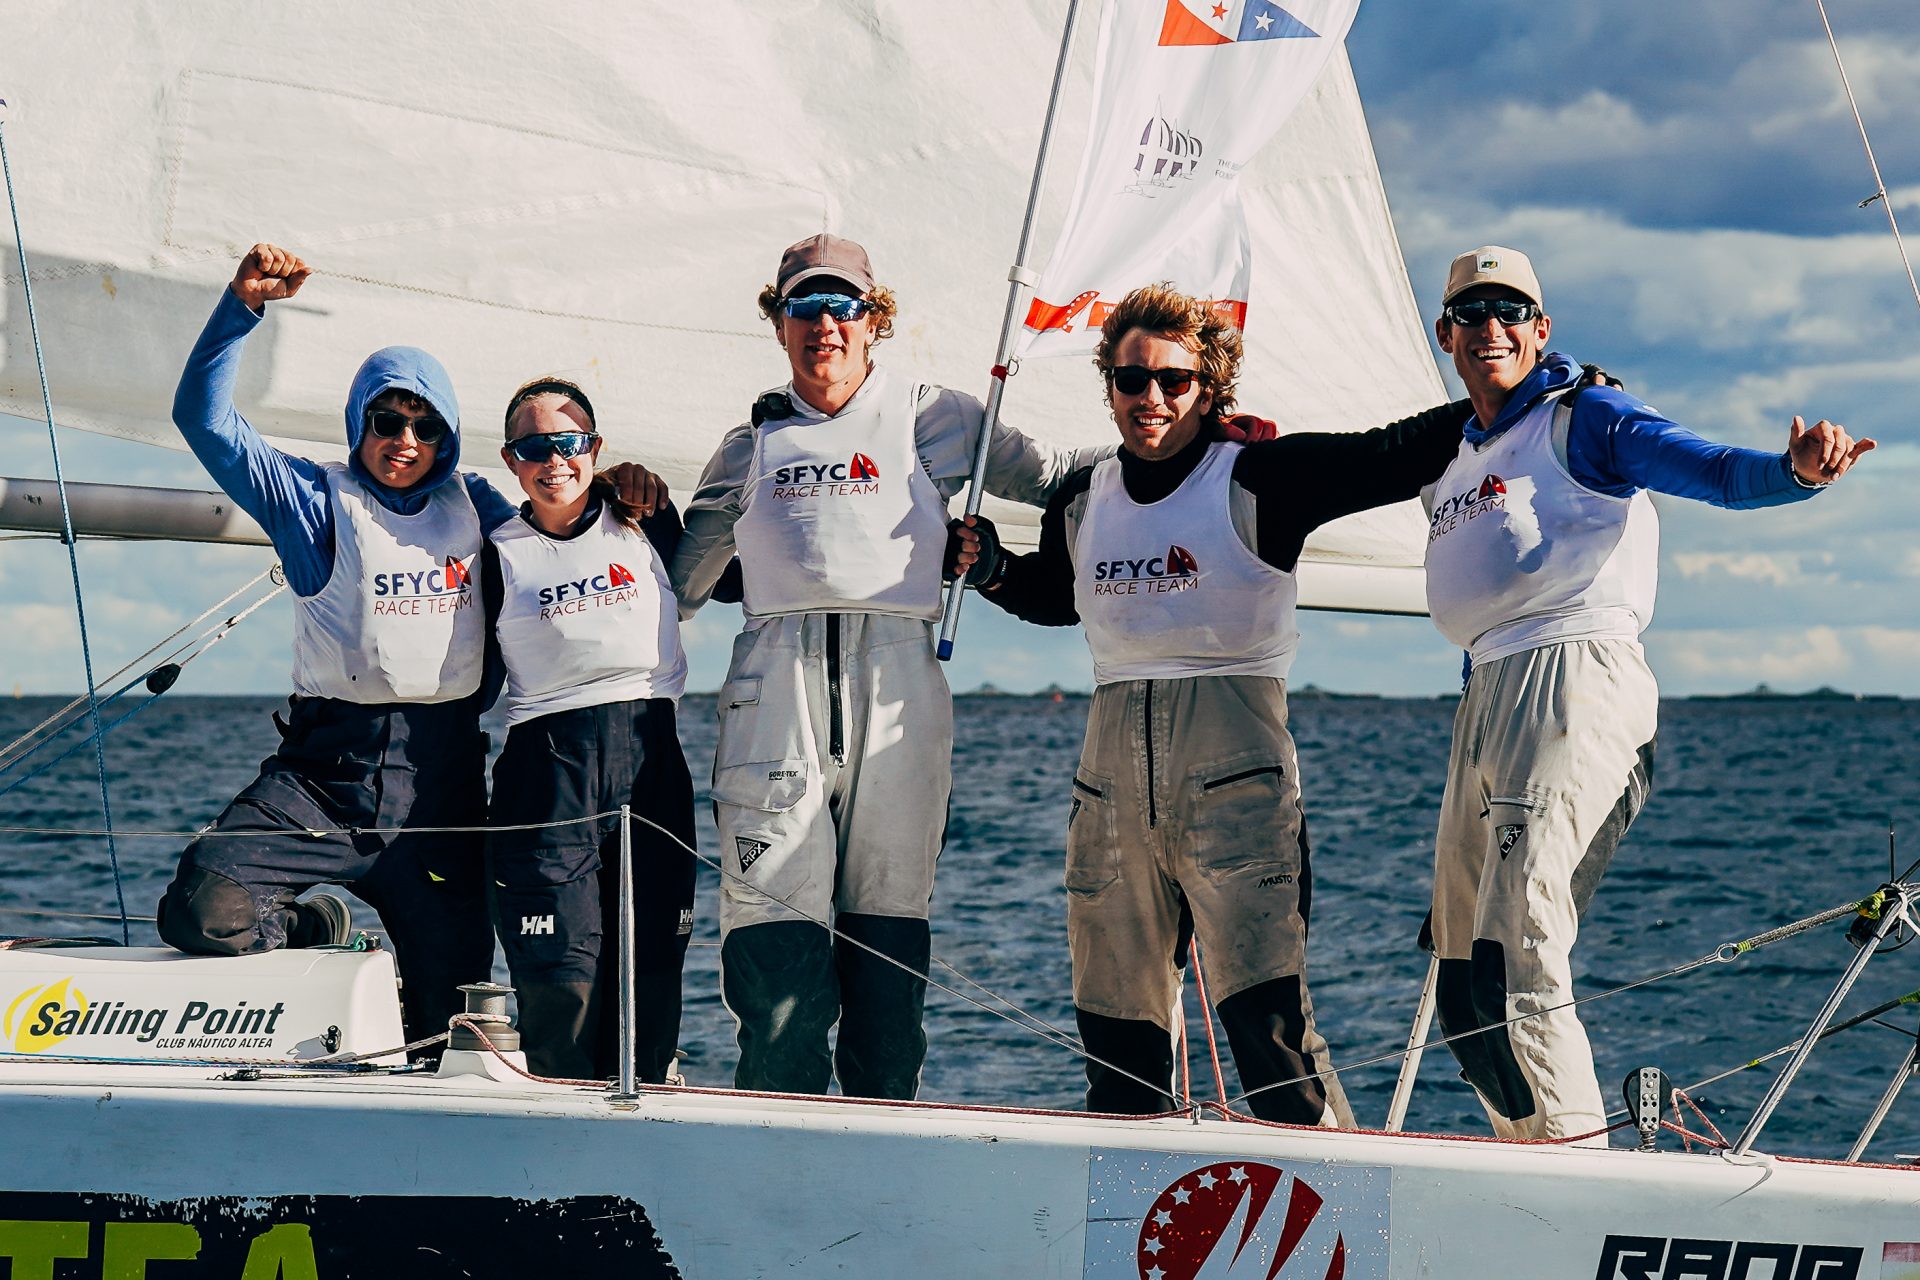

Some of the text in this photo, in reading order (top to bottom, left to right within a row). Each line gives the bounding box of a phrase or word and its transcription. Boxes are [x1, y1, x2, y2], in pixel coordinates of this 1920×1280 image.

[774, 463, 847, 485] SFYC
[773, 483, 879, 499] RACE TEAM
[1431, 487, 1478, 527] SFYC
[1429, 498, 1505, 542] RACE TEAM
[1095, 557, 1164, 580] SFYC
[374, 569, 443, 596] SFYC
[538, 574, 609, 606] SFYC
[1094, 577, 1198, 596] RACE TEAM
[373, 594, 473, 616] RACE TEAM
[539, 588, 639, 621] RACE TEAM
[1501, 826, 1522, 854] LPX
[742, 842, 765, 867] MPX
[1257, 874, 1293, 888] MUSTO
[520, 914, 555, 935] HH
[29, 1001, 285, 1043] Sailing Point
[156, 1035, 273, 1049] CLUB NÁUTICO ALTEA
